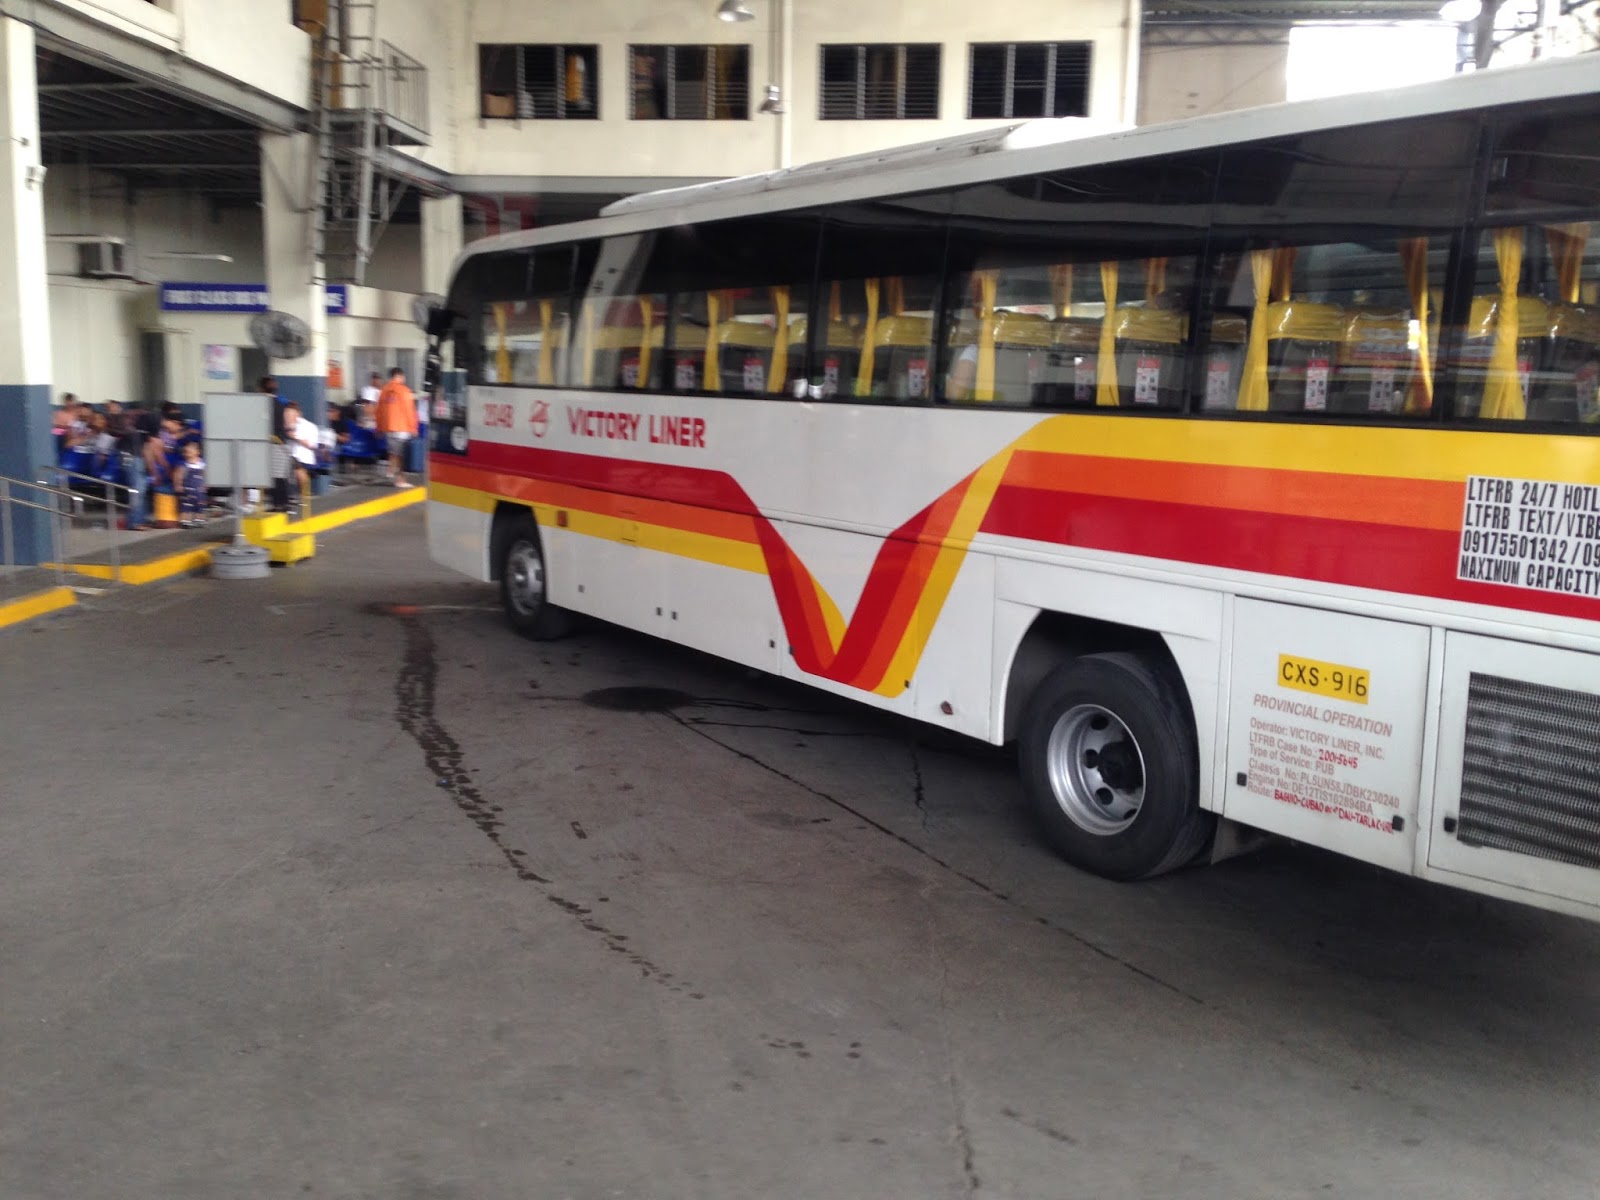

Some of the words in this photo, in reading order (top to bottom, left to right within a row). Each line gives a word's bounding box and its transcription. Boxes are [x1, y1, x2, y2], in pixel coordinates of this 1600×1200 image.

[566, 405, 641, 441] VICTORY
[648, 414, 705, 448] LINER
[1468, 477, 1513, 504] LTFRB
[1520, 481, 1558, 508] 24/7
[1465, 503, 1511, 530] LTFRB
[1459, 555, 1521, 585] MAXIMUM
[1526, 563, 1600, 596] CAPACITY
[1253, 693, 1319, 720] PROVINCIAL
[1322, 709, 1393, 737] OPERATION
[1249, 731, 1275, 747] LTFRB
[1277, 739, 1298, 753] Case
[1250, 717, 1288, 736] Operator:
[1290, 727, 1330, 745] VICTORY
[1365, 744, 1385, 760] INC.
[1248, 757, 1280, 775] Chassis
[1249, 743, 1268, 757] Type
[1269, 750, 1278, 760] of
[1315, 760, 1335, 775] PUB
[1248, 769, 1275, 786] Engine
